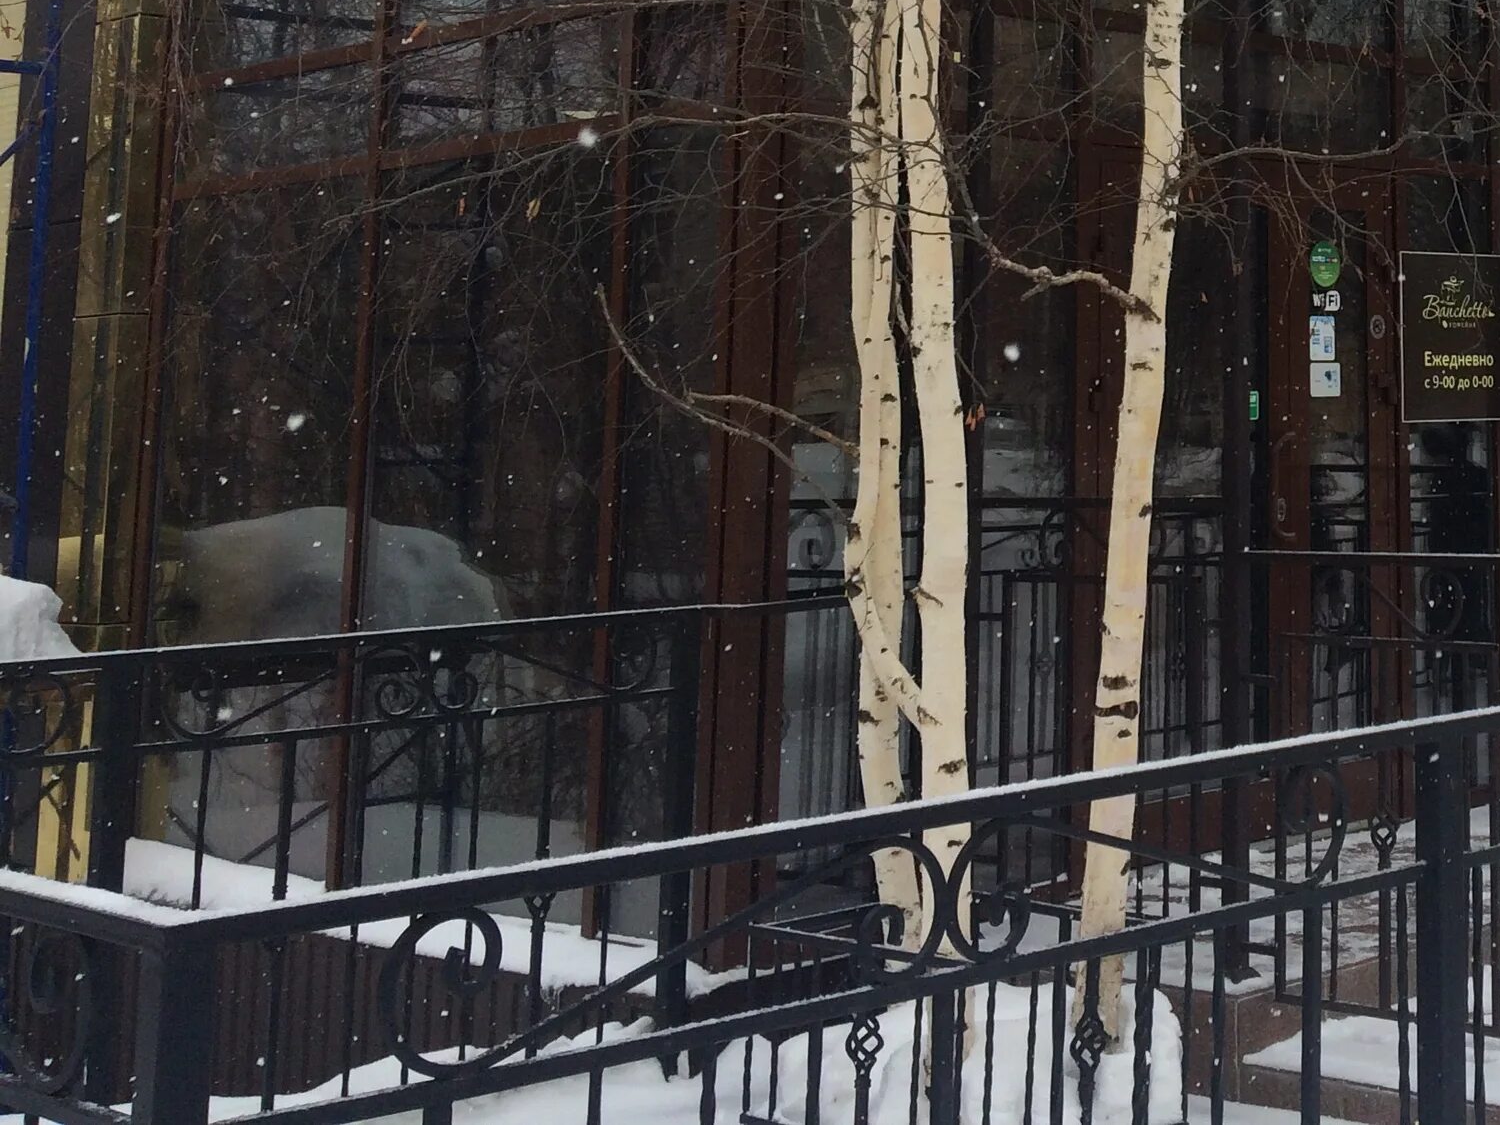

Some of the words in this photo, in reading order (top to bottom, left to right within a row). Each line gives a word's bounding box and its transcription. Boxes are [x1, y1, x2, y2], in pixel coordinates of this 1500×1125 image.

[1424, 351, 1494, 370] Ежедневно
[1424, 378, 1431, 389] с
[1432, 375, 1455, 389] 9-00
[1457, 378, 1470, 391] до
[1472, 375, 1494, 388] 0-00
